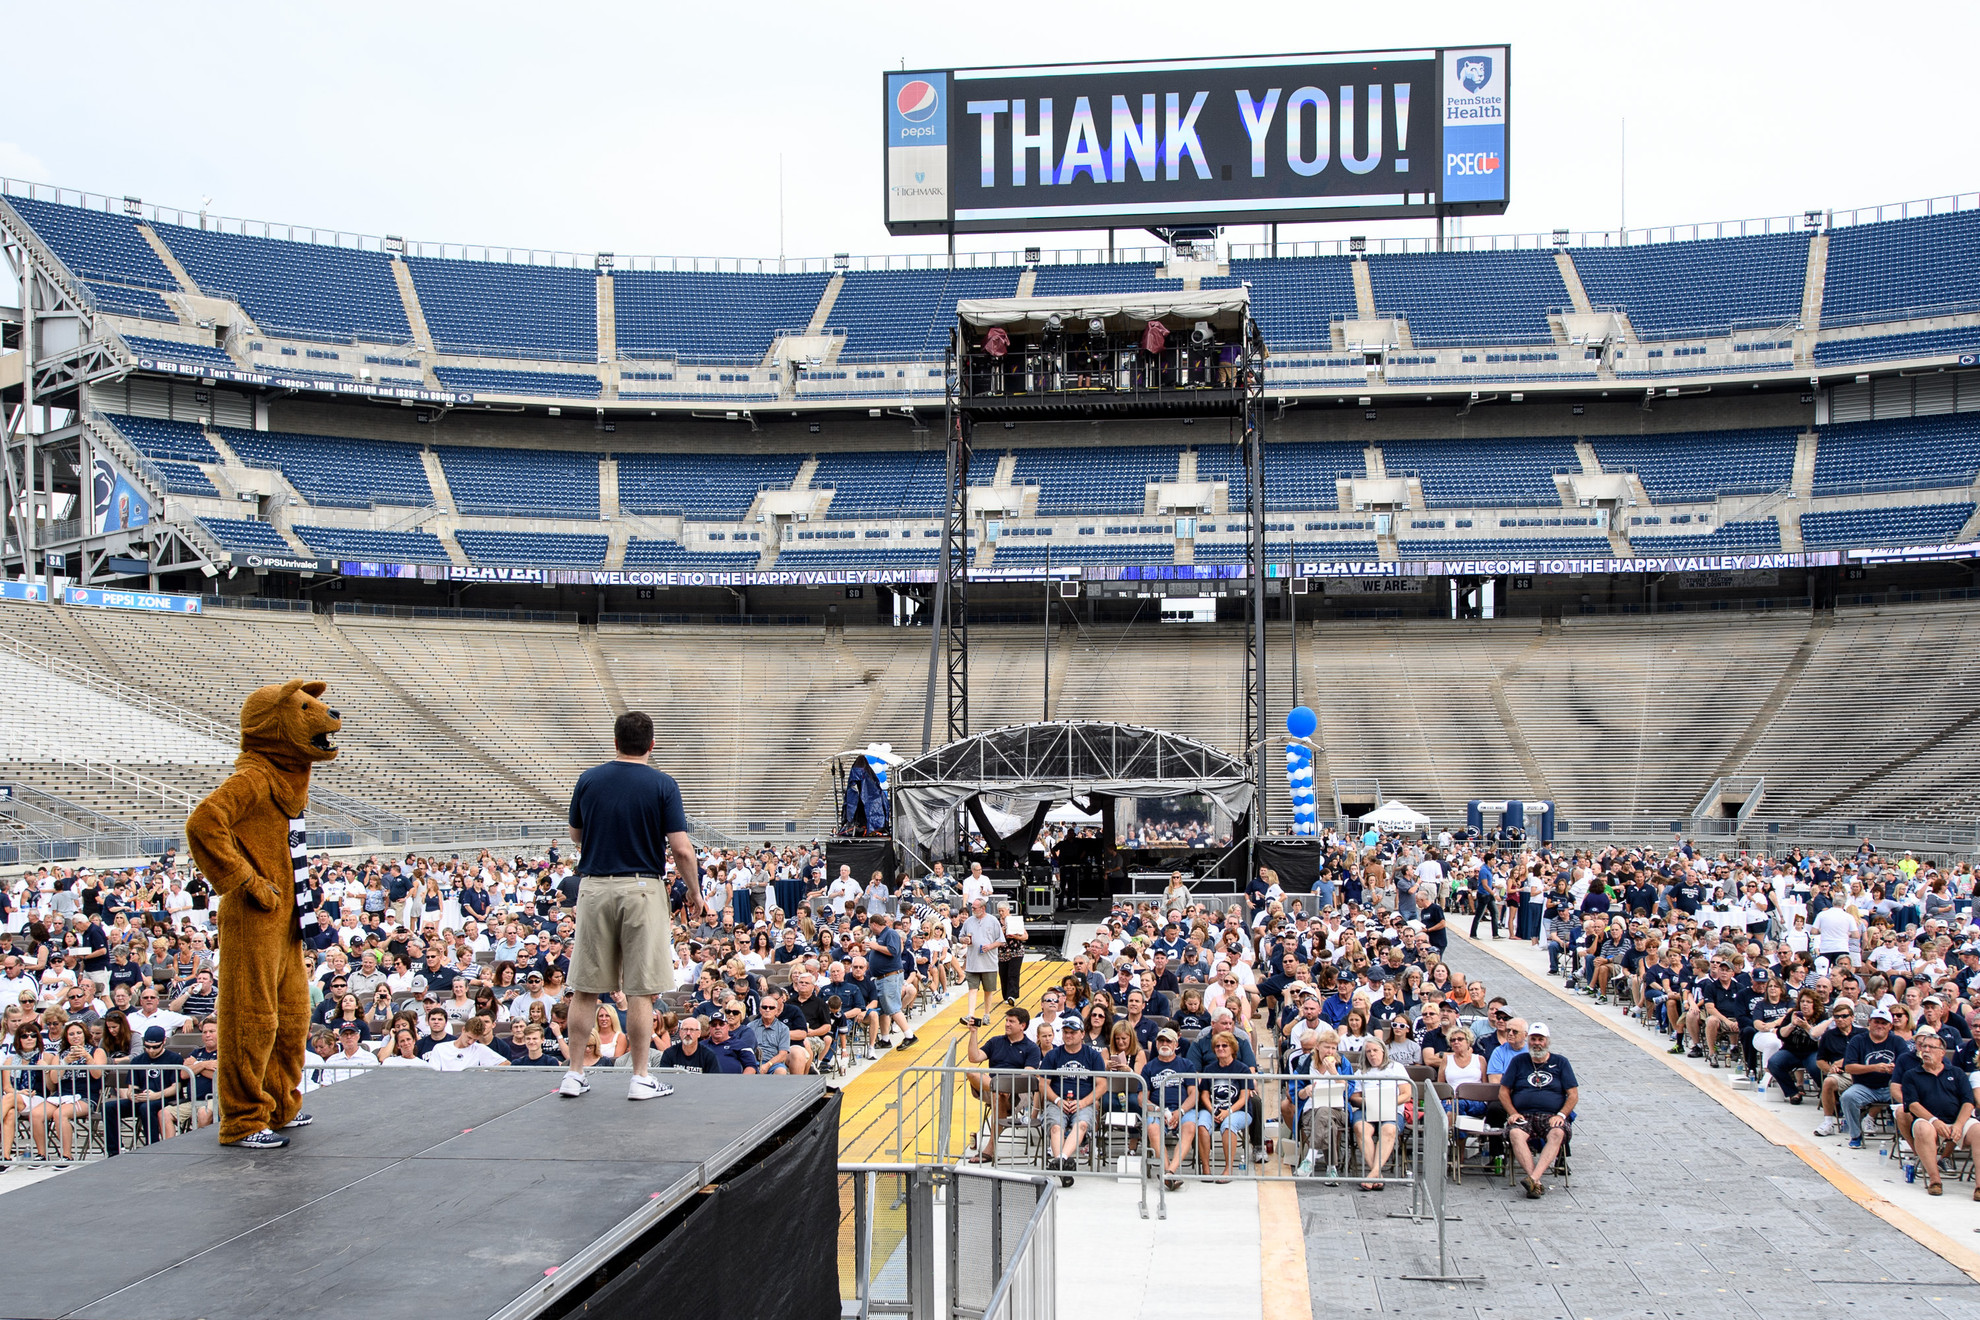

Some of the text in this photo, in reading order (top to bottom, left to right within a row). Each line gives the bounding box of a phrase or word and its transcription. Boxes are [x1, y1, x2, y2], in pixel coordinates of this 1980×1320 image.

[1447, 96, 1501, 106] PennState
[1447, 106, 1501, 119] Health
[901, 125, 935, 139] pepsi
[966, 83, 1411, 187] THANK YOU!
[1447, 152, 1494, 176] PSECU
[598, 256, 614, 266] SCU
[1025, 251, 1040, 261] SEU
[157, 361, 177, 372] NEED
[180, 364, 204, 376] HELP?
[210, 368, 228, 378] Text
[230, 371, 272, 384] "NITTANY"
[313, 380, 335, 391] YOUR
[339, 383, 376, 394] LOCATION
[379, 386, 394, 396] and
[396, 388, 418, 398] ISSUE
[421, 390, 429, 399] to
[50, 556, 61, 566] SA
[263, 559, 318, 570] #PSUnrivaled
[1445, 552, 1796, 574] WELCOME TO THE HAPPY VALLEY JAM!
[450, 566, 542, 580] BEAVER
[1303, 562, 1394, 574] BEAVER
[591, 570, 911, 585] WELCOME TO THE HAPPY VALLEY JAM!
[1309, 583, 1319, 591] SF
[1363, 580, 1381, 592] WE
[1384, 580, 1419, 591] ARE...
[1517, 580, 1528, 588] SG
[641, 590, 651, 598] SC
[849, 589, 860, 598] SD
[102, 593, 171, 609] PEPSI ZONE
[1167, 949, 1178, 959] 2
